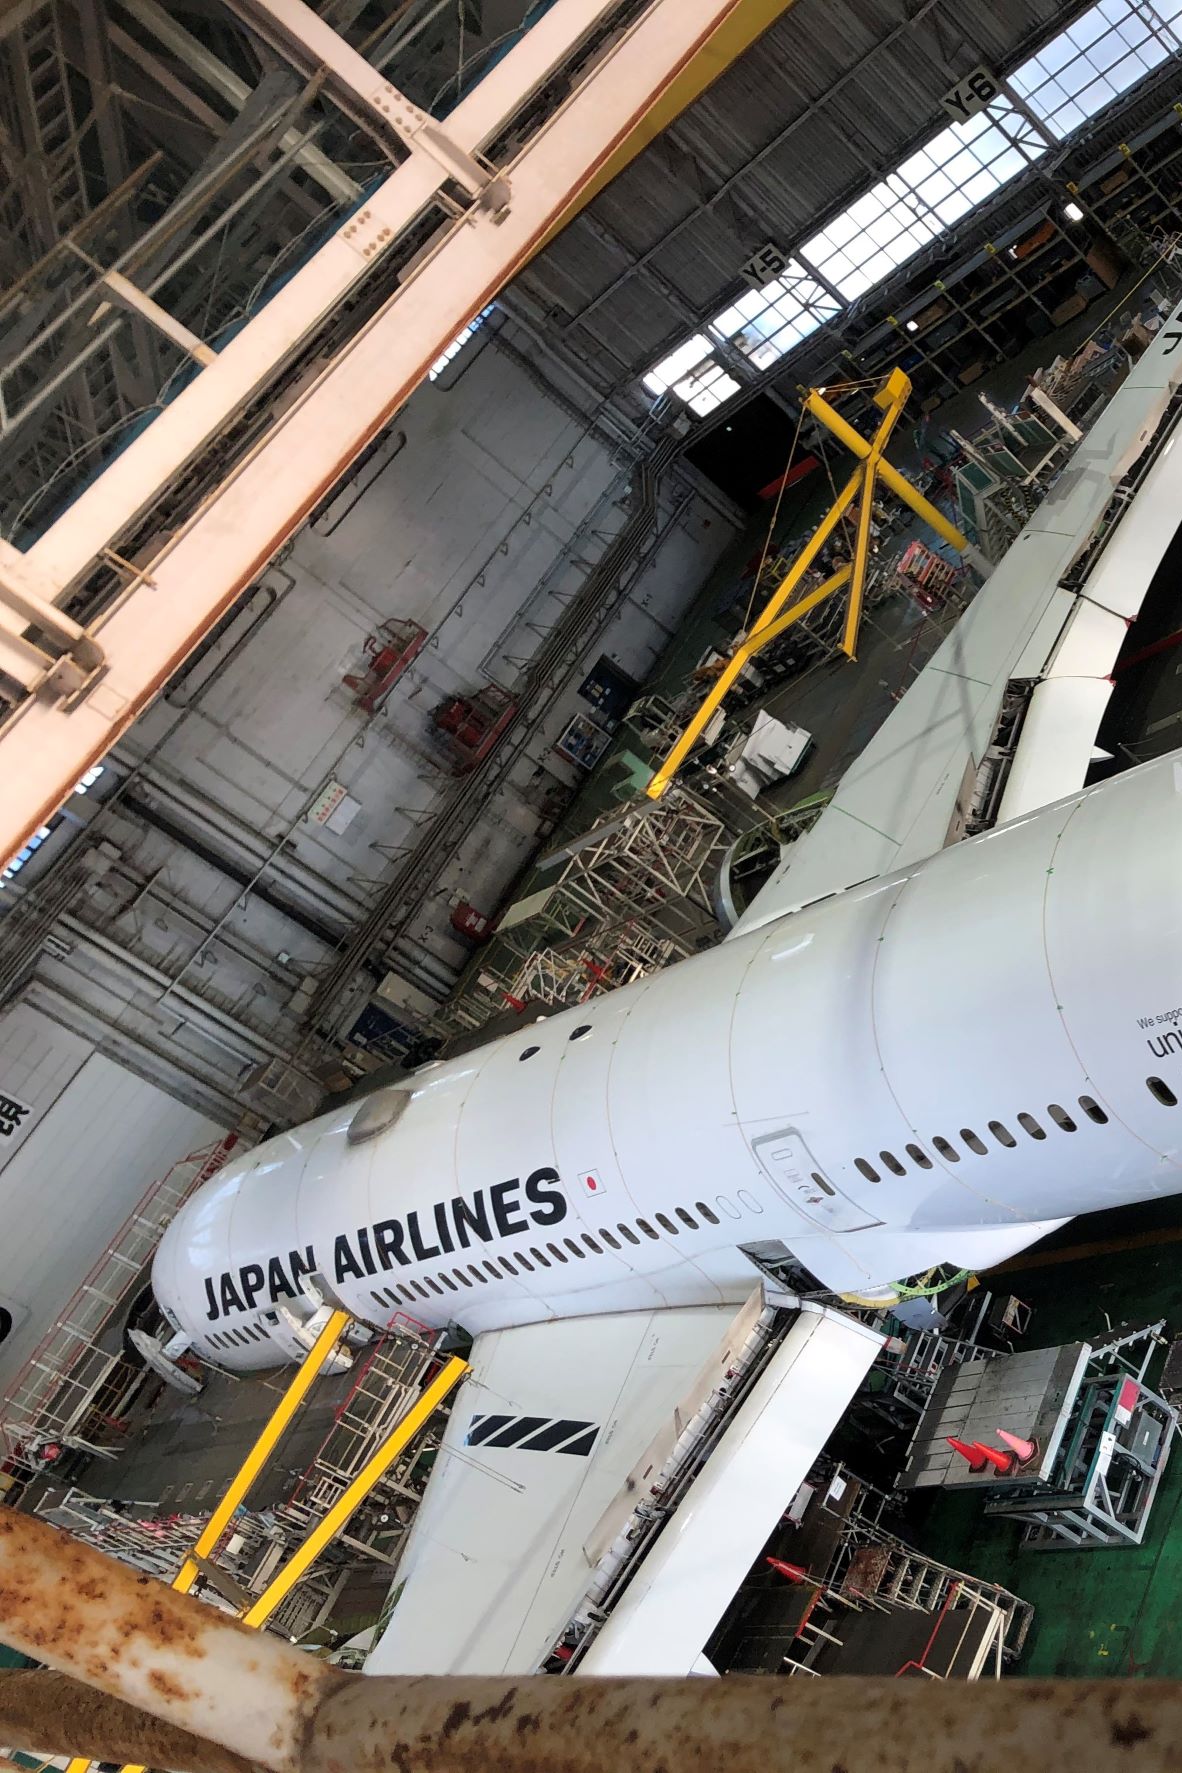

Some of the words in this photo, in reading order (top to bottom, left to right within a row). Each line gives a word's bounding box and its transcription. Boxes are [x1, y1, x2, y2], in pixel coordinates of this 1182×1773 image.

[944, 73, 996, 116] Y-6
[743, 249, 785, 285] Y-5
[1136, 1017, 1155, 1029] We
[205, 1245, 317, 1321] JAPAN
[334, 1167, 568, 1285] AIRLINES
